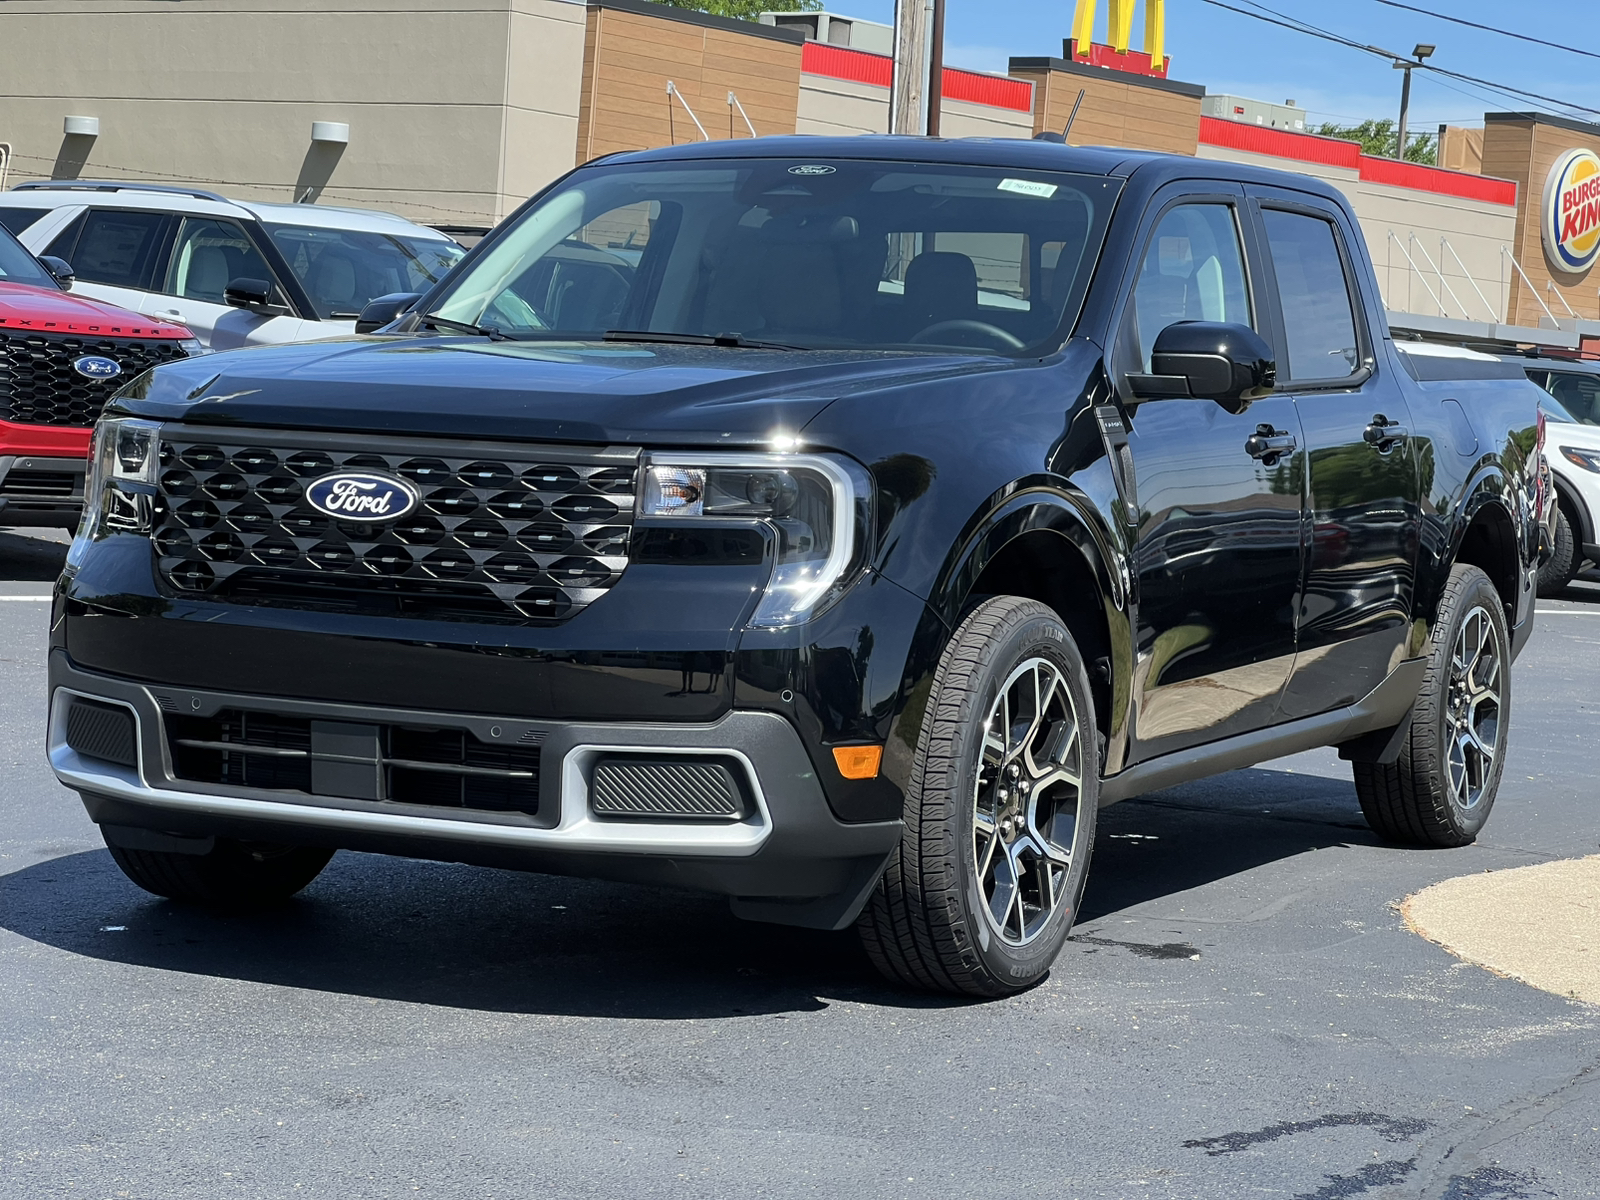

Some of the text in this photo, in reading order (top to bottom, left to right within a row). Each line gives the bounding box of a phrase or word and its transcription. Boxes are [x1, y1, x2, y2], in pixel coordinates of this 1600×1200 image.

[1563, 176, 1600, 214] BURGE
[1560, 198, 1600, 244] KIN
[325, 480, 393, 514] Ford
